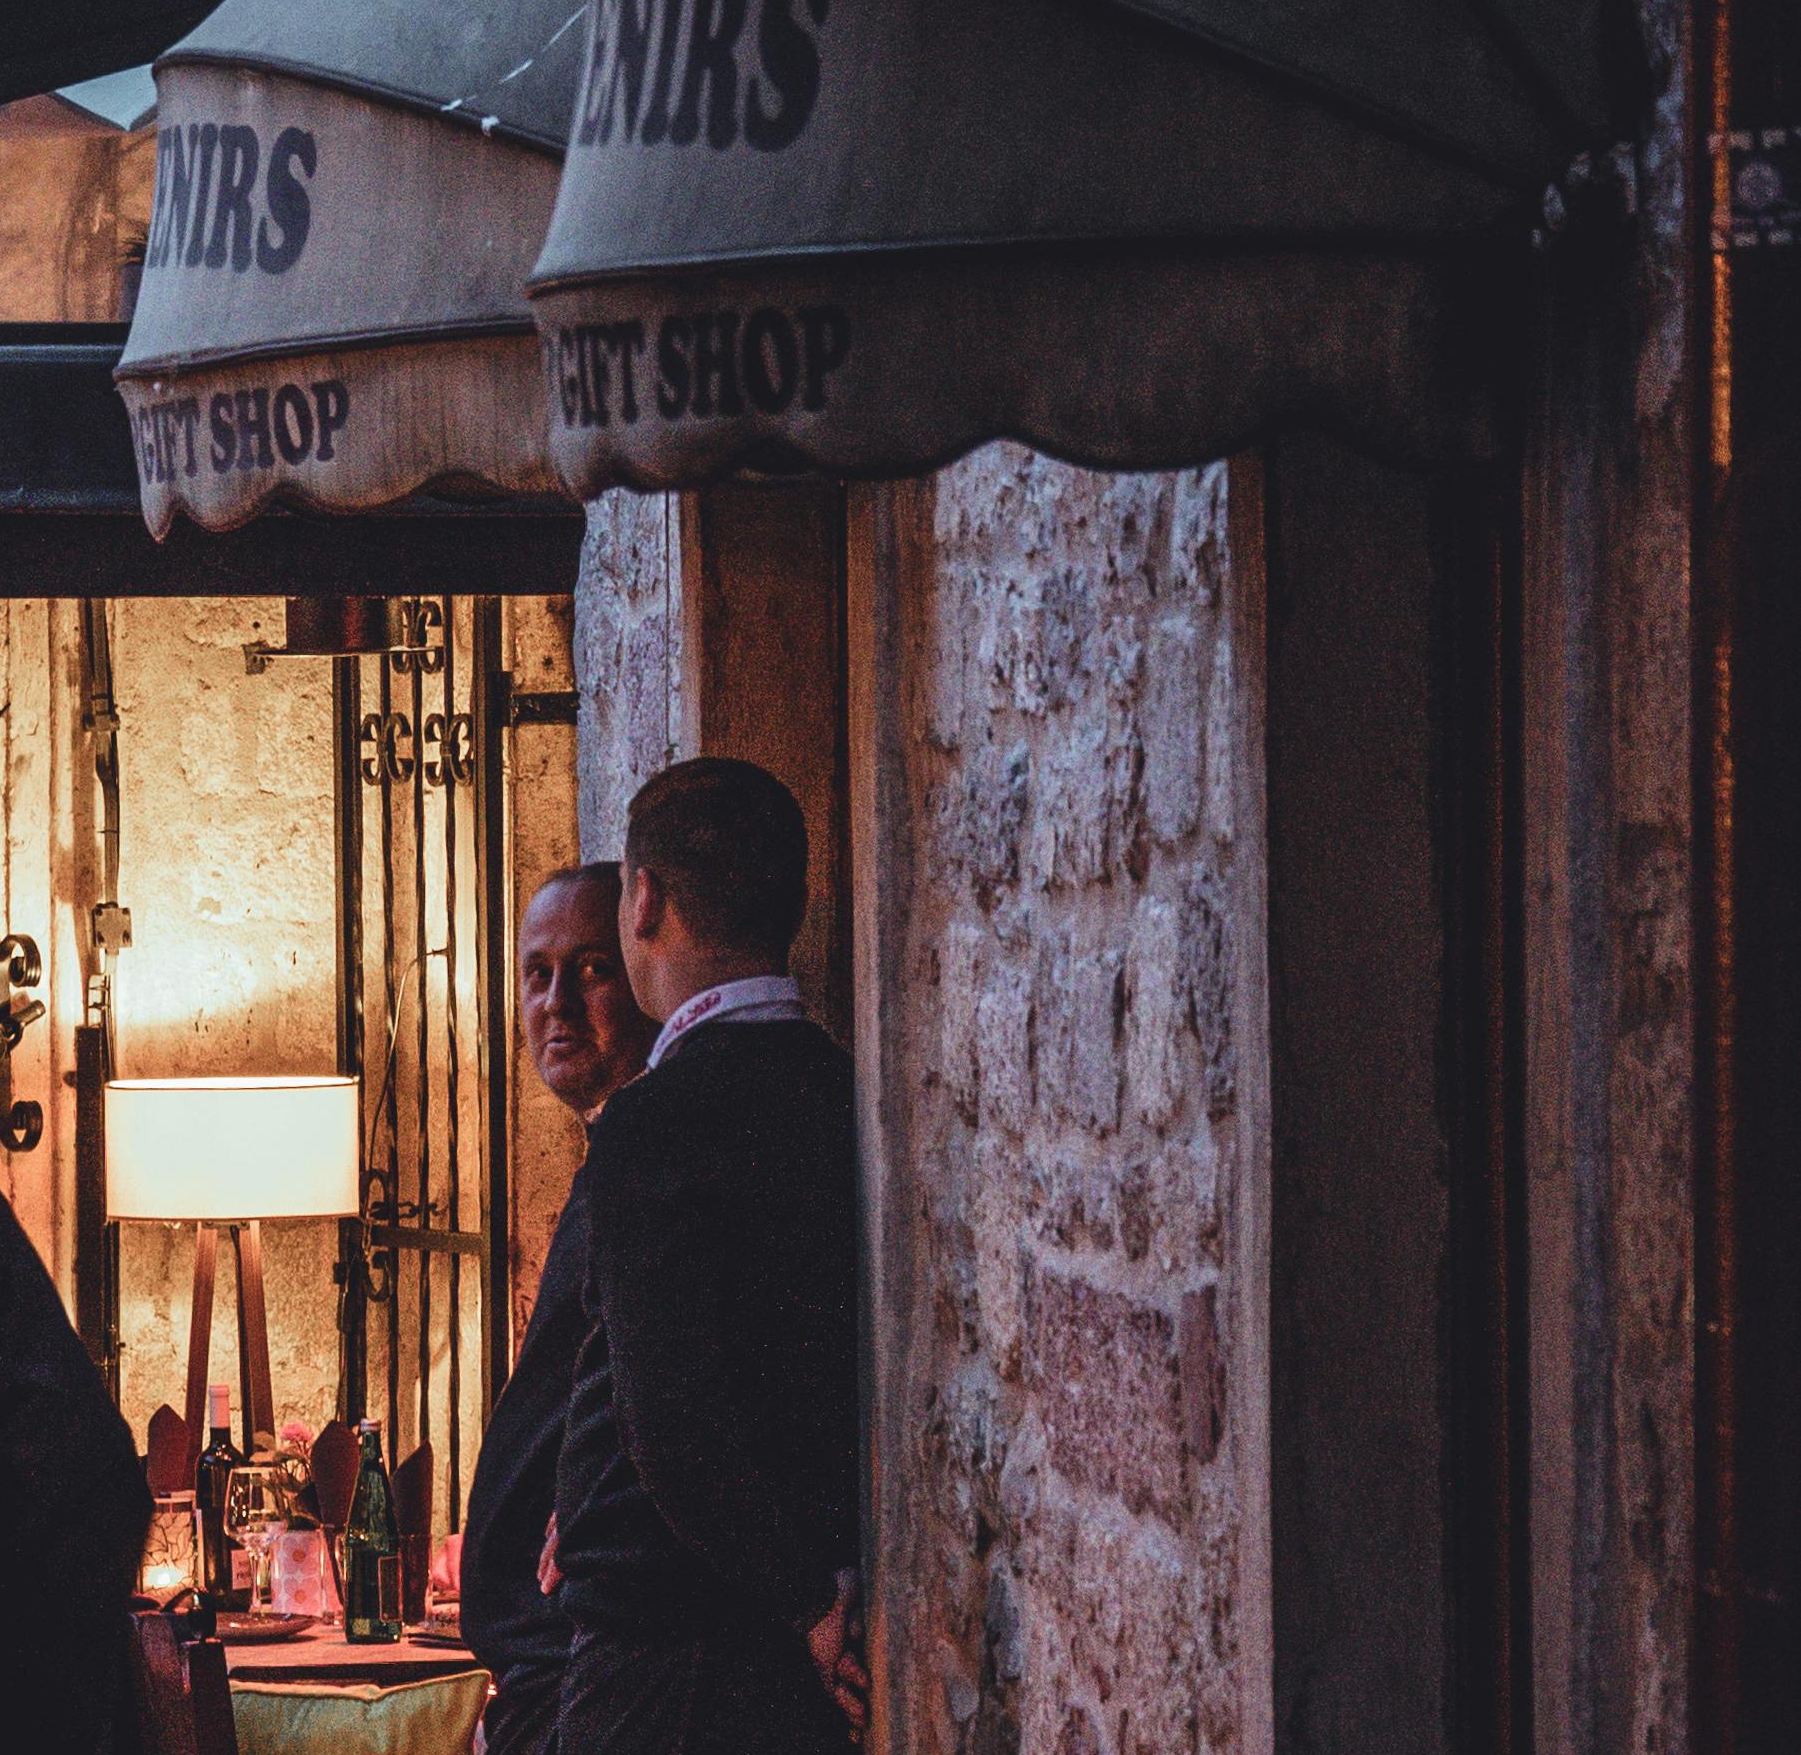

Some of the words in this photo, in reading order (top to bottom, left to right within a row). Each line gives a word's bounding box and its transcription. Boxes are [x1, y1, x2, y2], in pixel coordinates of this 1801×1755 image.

[559, 318, 646, 428] GIFT
[658, 305, 852, 420] SHOP
[139, 396, 200, 484] GIFT
[209, 380, 349, 475] SHOP
